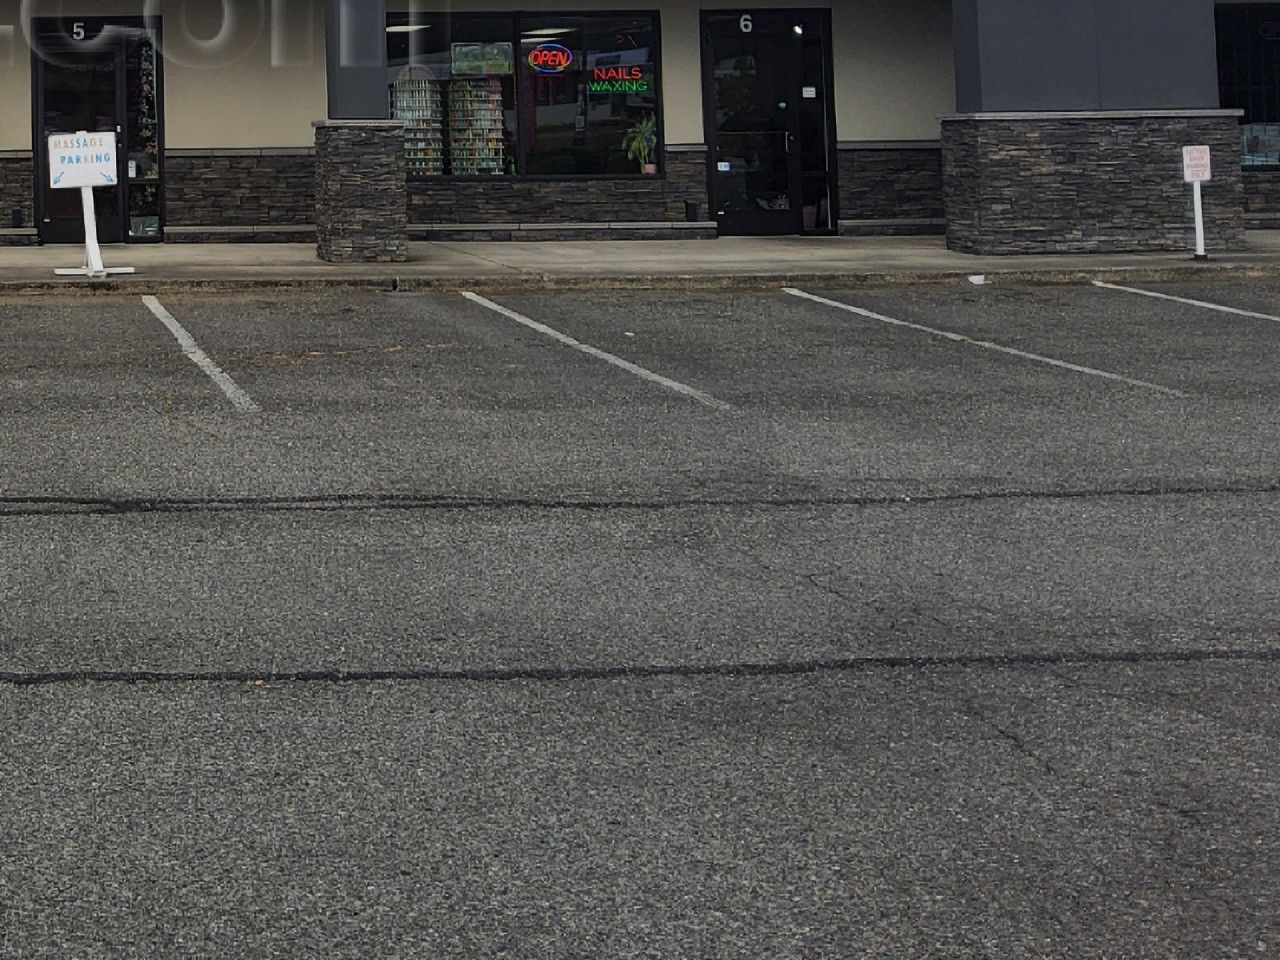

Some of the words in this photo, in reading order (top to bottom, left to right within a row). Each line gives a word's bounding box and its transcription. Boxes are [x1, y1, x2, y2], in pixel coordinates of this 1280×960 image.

[739, 14, 753, 33] 6
[72, 22, 85, 40] 5
[530, 50, 568, 66] OPEN
[593, 66, 642, 80] NAILS
[587, 80, 648, 92] WAXING
[53, 137, 104, 149] MASSAGE
[60, 152, 111, 164] PARKING
